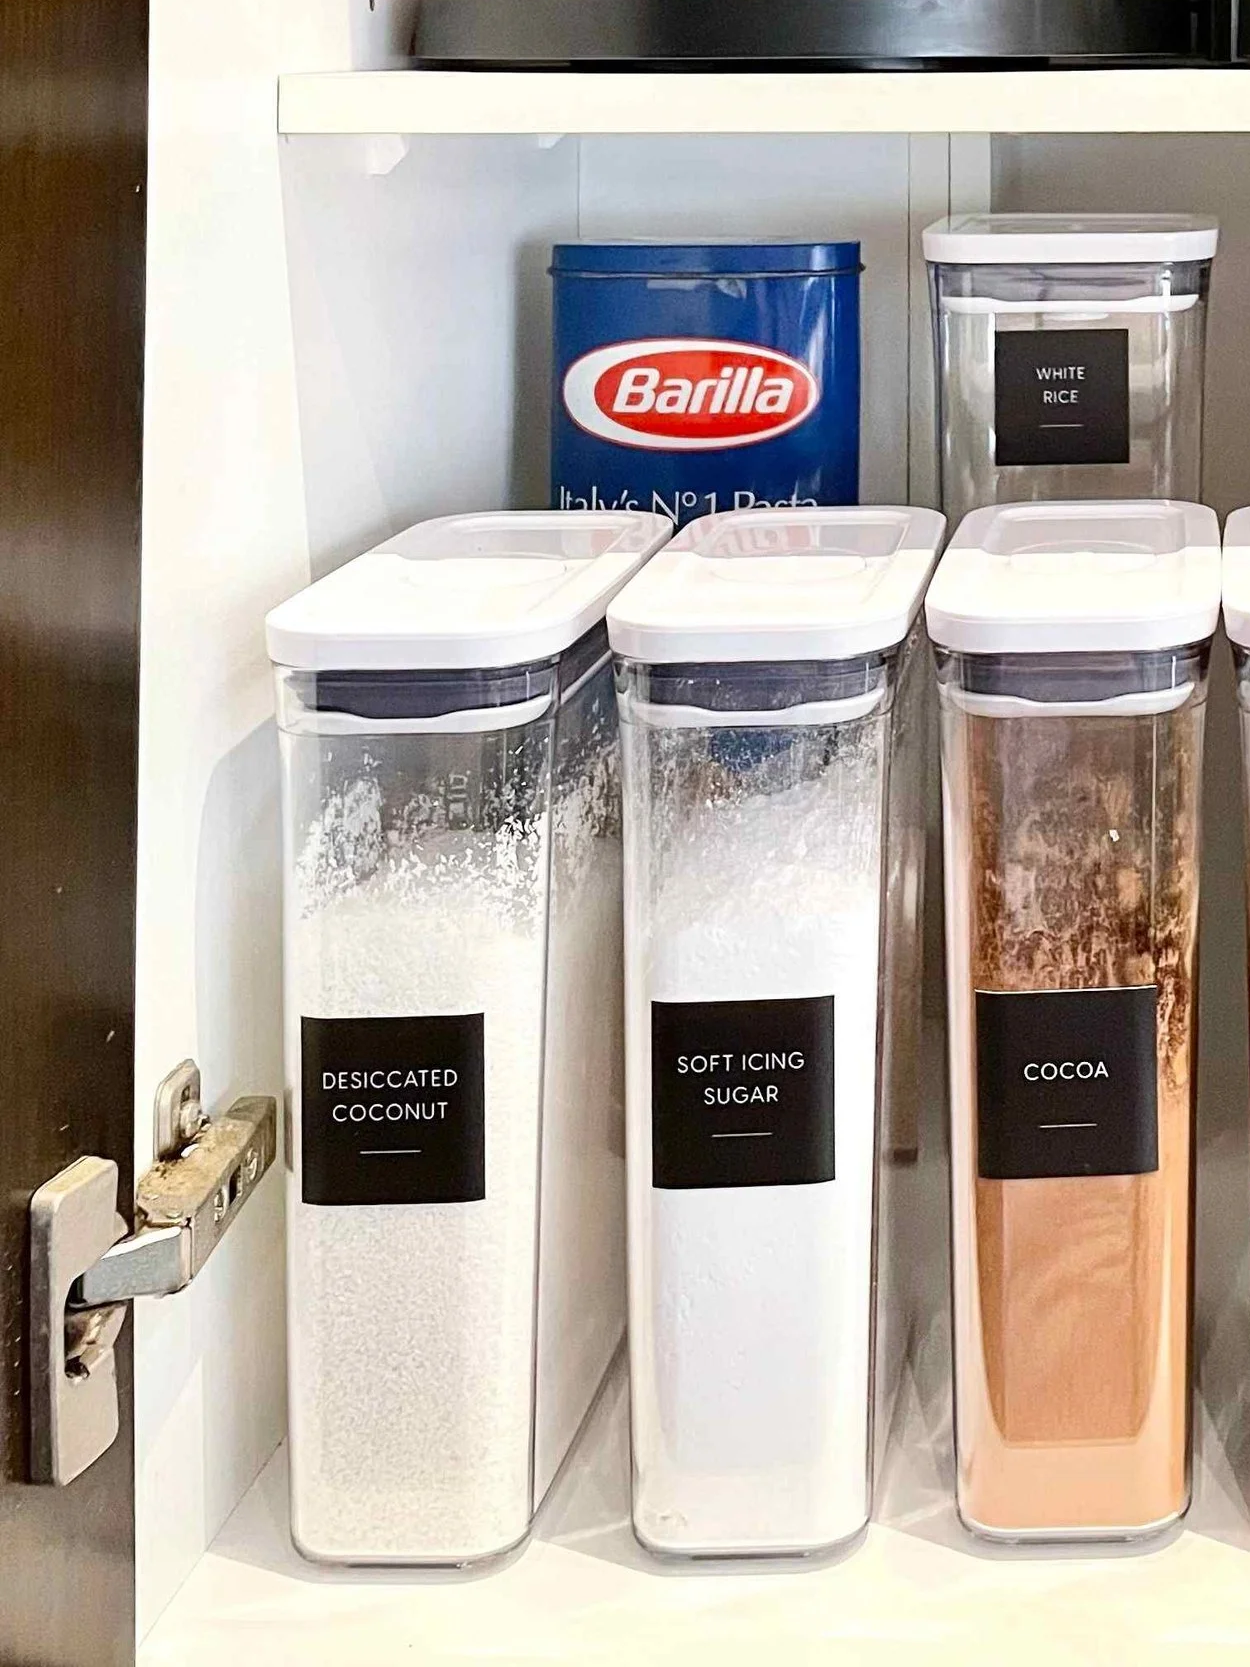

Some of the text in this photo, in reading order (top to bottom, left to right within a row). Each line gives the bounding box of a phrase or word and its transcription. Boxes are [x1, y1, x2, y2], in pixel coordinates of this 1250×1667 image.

[1036, 366, 1086, 381] WHITE
[612, 366, 795, 414] Barilla
[1042, 390, 1079, 404] RICE
[677, 1051, 805, 1074] SOFT ICING
[1023, 1061, 1110, 1081] COCOA
[322, 1069, 458, 1090] DESICCATED
[704, 1085, 779, 1105] SUGAR
[332, 1101, 449, 1122] COCONUT
